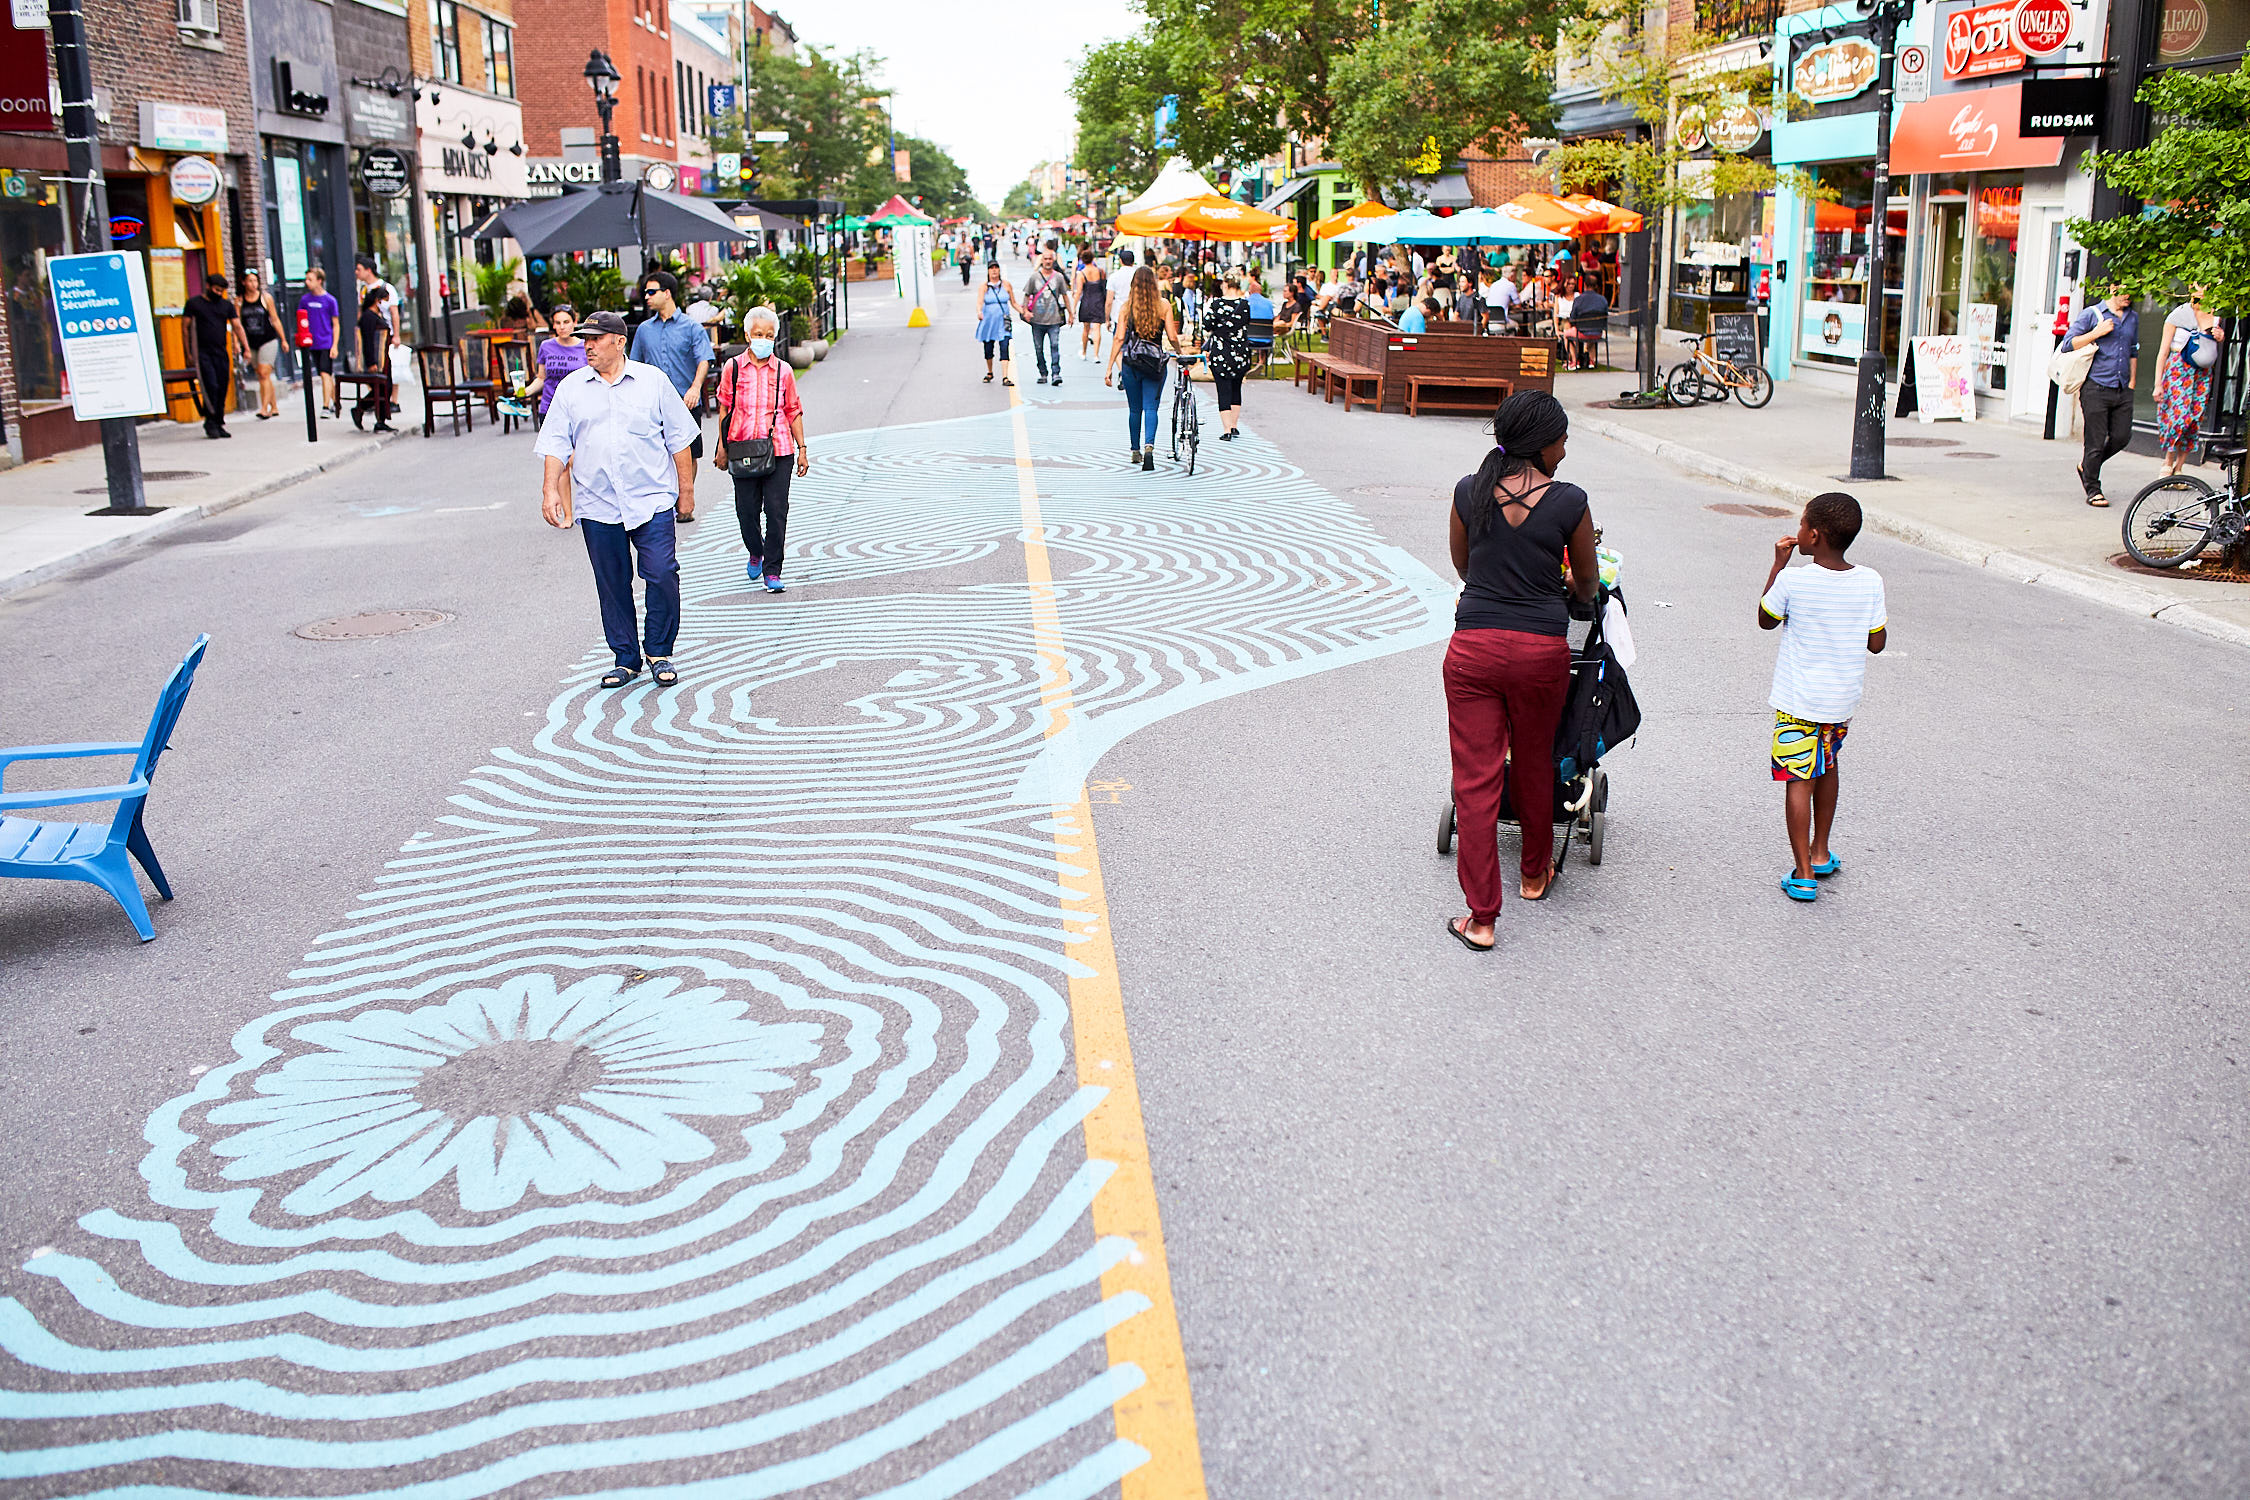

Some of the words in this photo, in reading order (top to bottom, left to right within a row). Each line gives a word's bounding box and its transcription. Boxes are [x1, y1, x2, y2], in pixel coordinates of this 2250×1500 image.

[2020, 10, 2067, 34] ONGLES
[1971, 21, 2011, 55] OPI
[2039, 33, 2058, 45] OPI
[0, 98, 47, 113] oom
[2031, 114, 2095, 128] RUDSAK
[1980, 186, 2023, 224] ONGLE
[56, 277, 86, 290] Voies
[60, 288, 97, 300] Actives
[61, 297, 120, 311] Sécuritaires
[1918, 338, 1962, 364] Ongles
